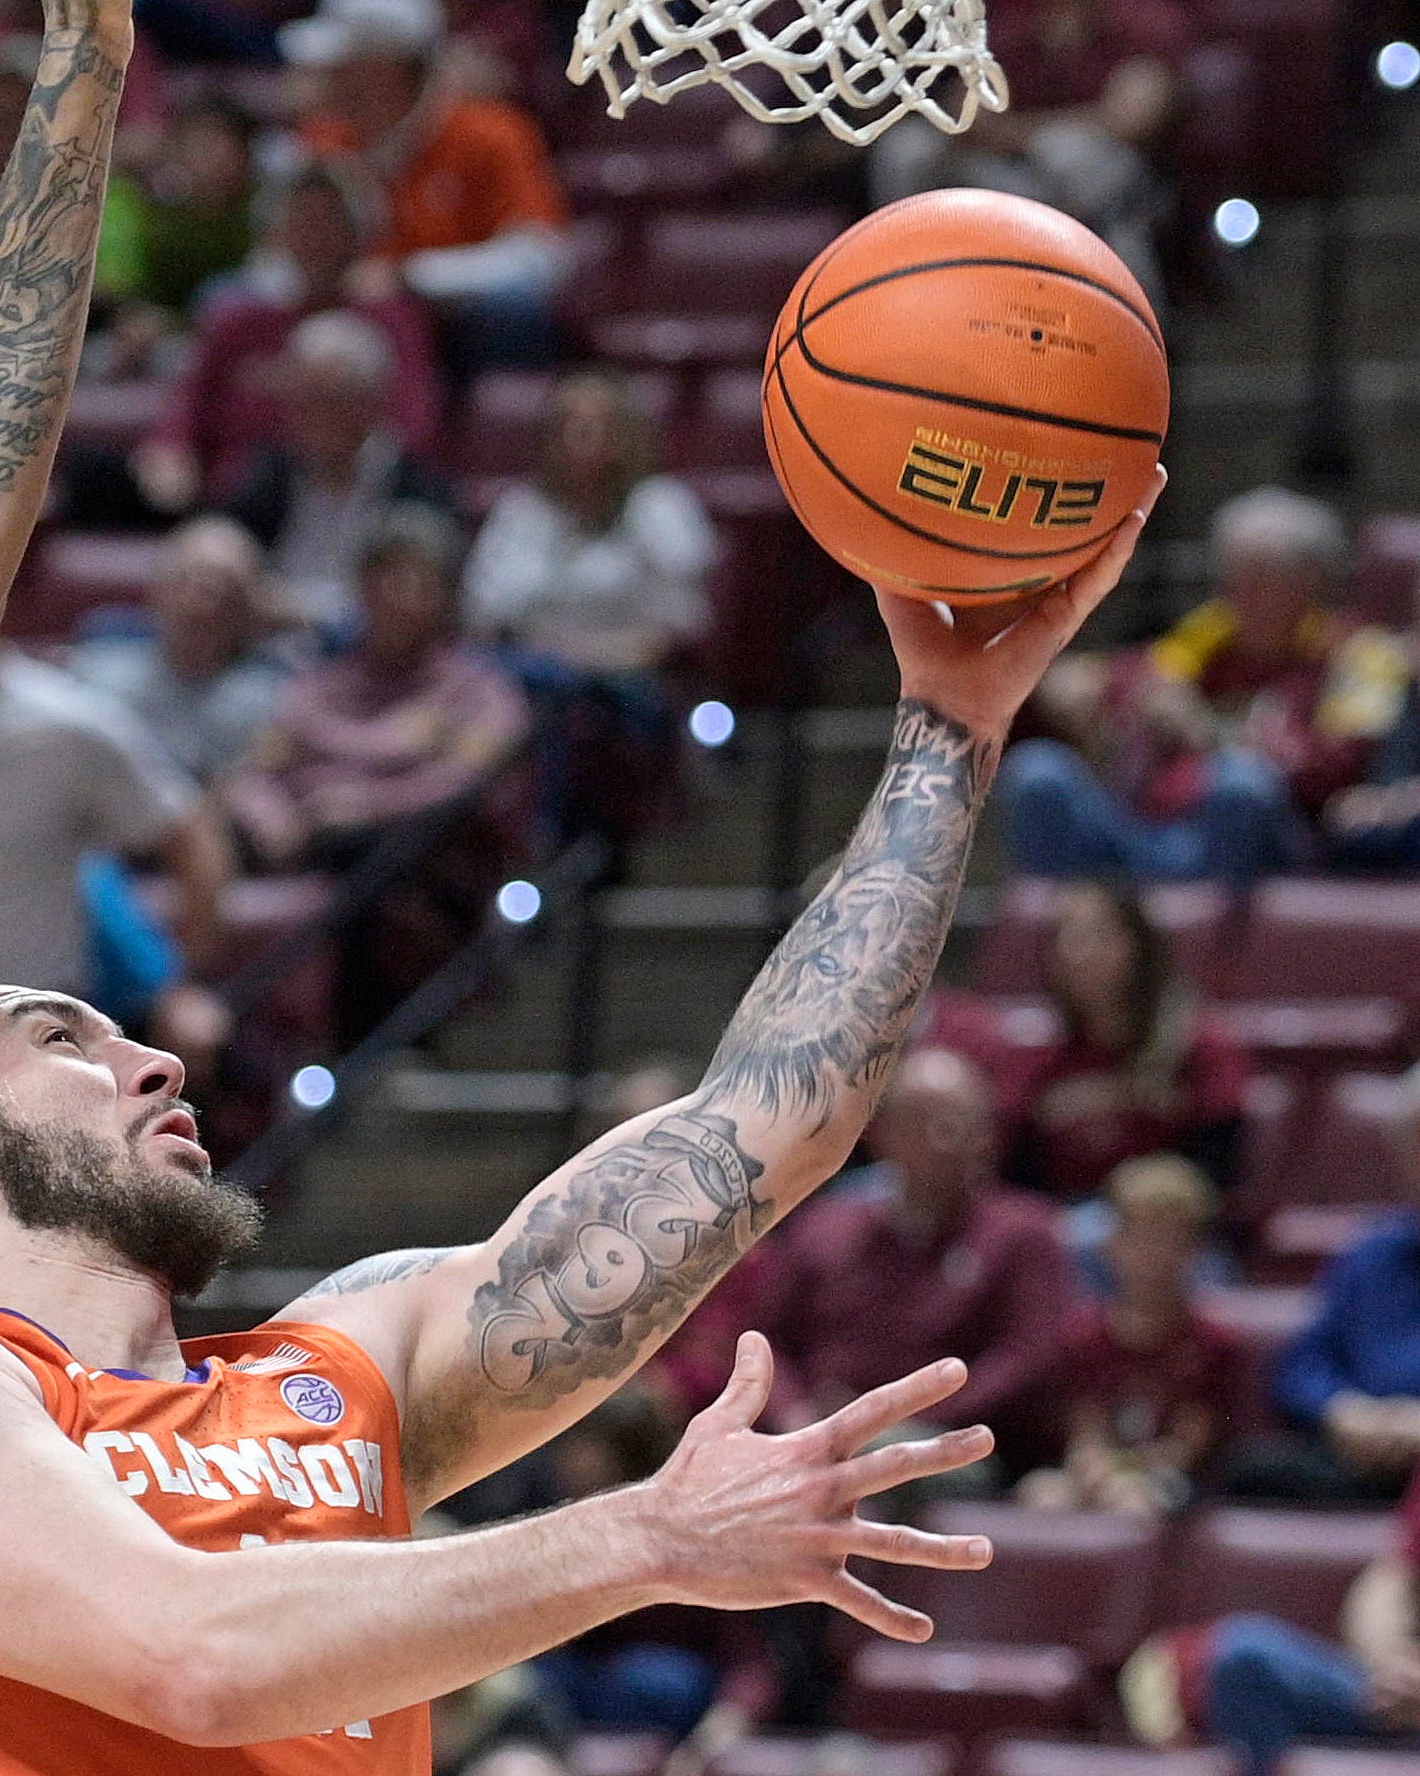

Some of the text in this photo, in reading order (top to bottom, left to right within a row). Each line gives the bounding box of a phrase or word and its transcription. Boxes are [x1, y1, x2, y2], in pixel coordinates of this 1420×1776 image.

[897, 440, 1107, 530] ELITE
[296, 1384, 334, 1404] ACC
[83, 1430, 384, 1519] CLEMSON
